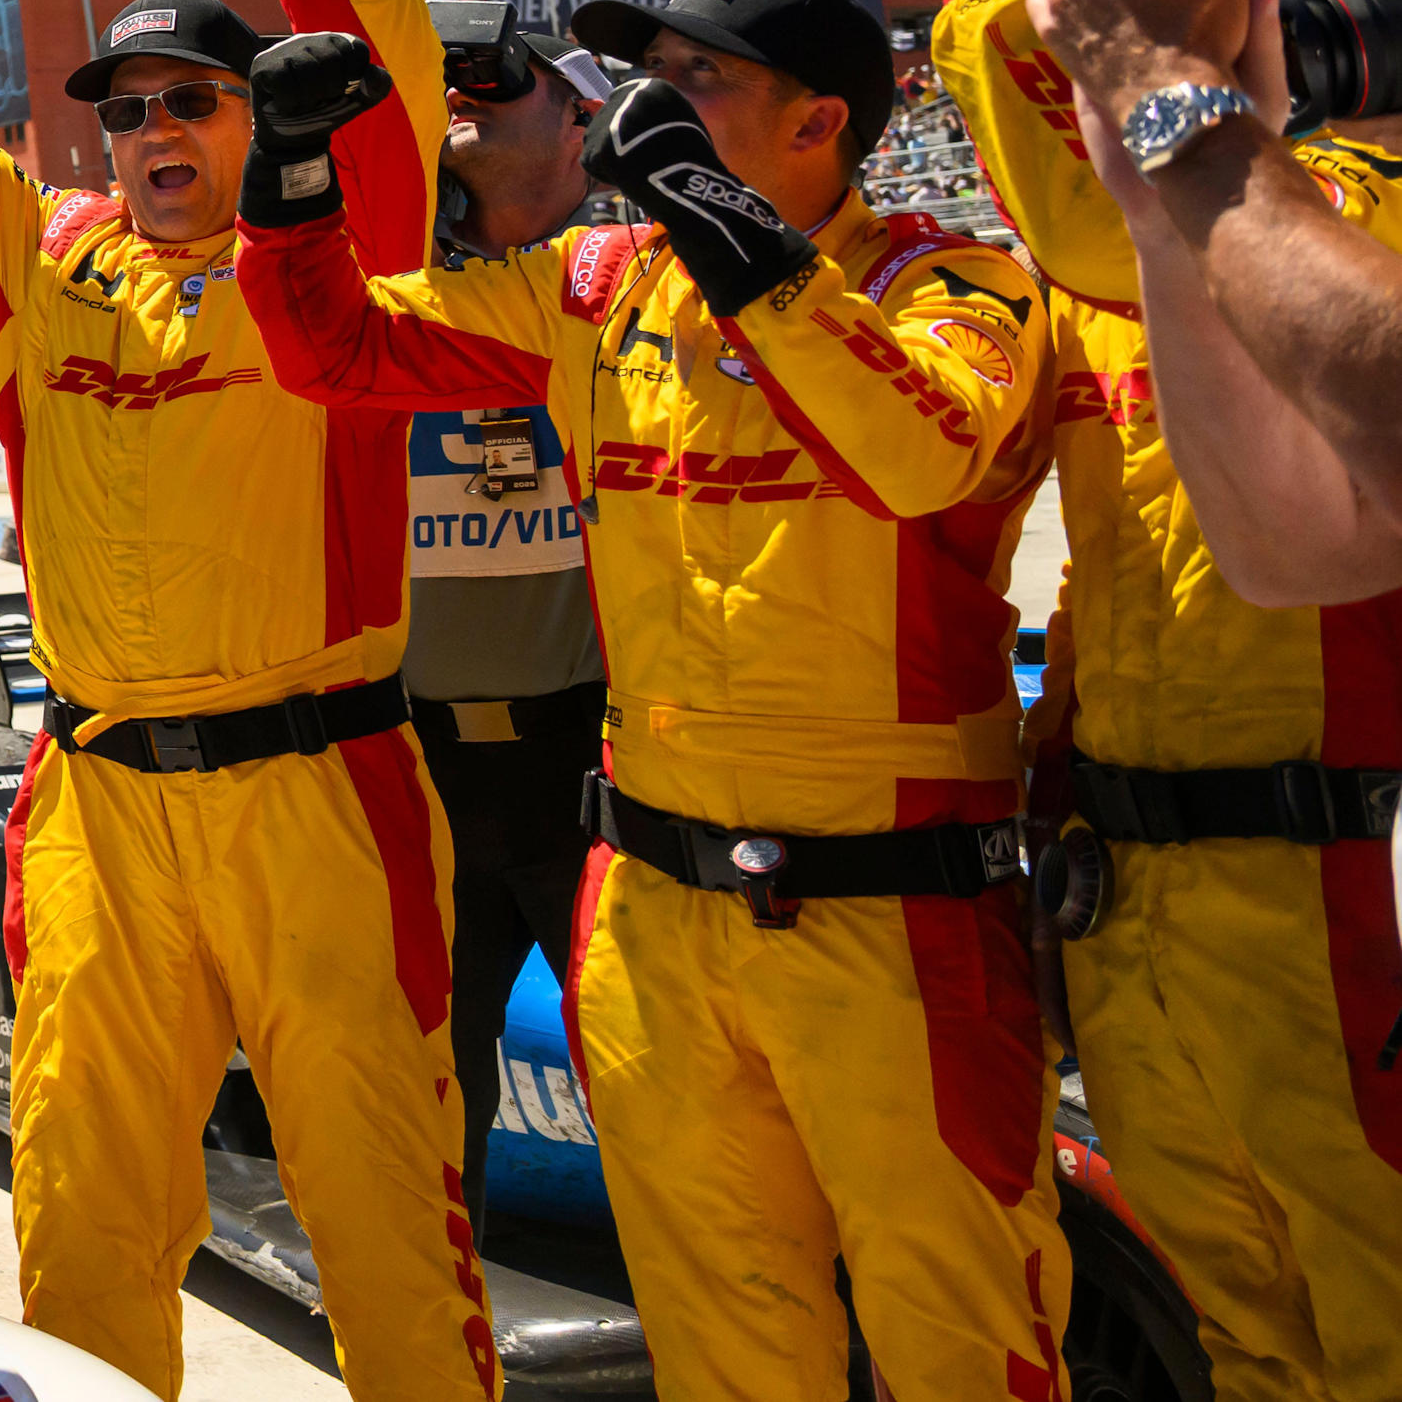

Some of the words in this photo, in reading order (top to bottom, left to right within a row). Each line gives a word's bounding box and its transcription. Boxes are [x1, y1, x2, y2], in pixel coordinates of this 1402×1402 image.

[468, 19, 495, 27] SONY
[44, 194, 94, 239] sparco
[686, 173, 786, 232] sparco
[140, 248, 206, 261] DHL
[573, 230, 611, 298] sparco
[46, 352, 224, 410] DHL
[597, 360, 674, 384] Honda
[842, 318, 979, 449] DHL
[485, 437, 530, 446] OFFICIAL
[595, 441, 818, 504] DHL
